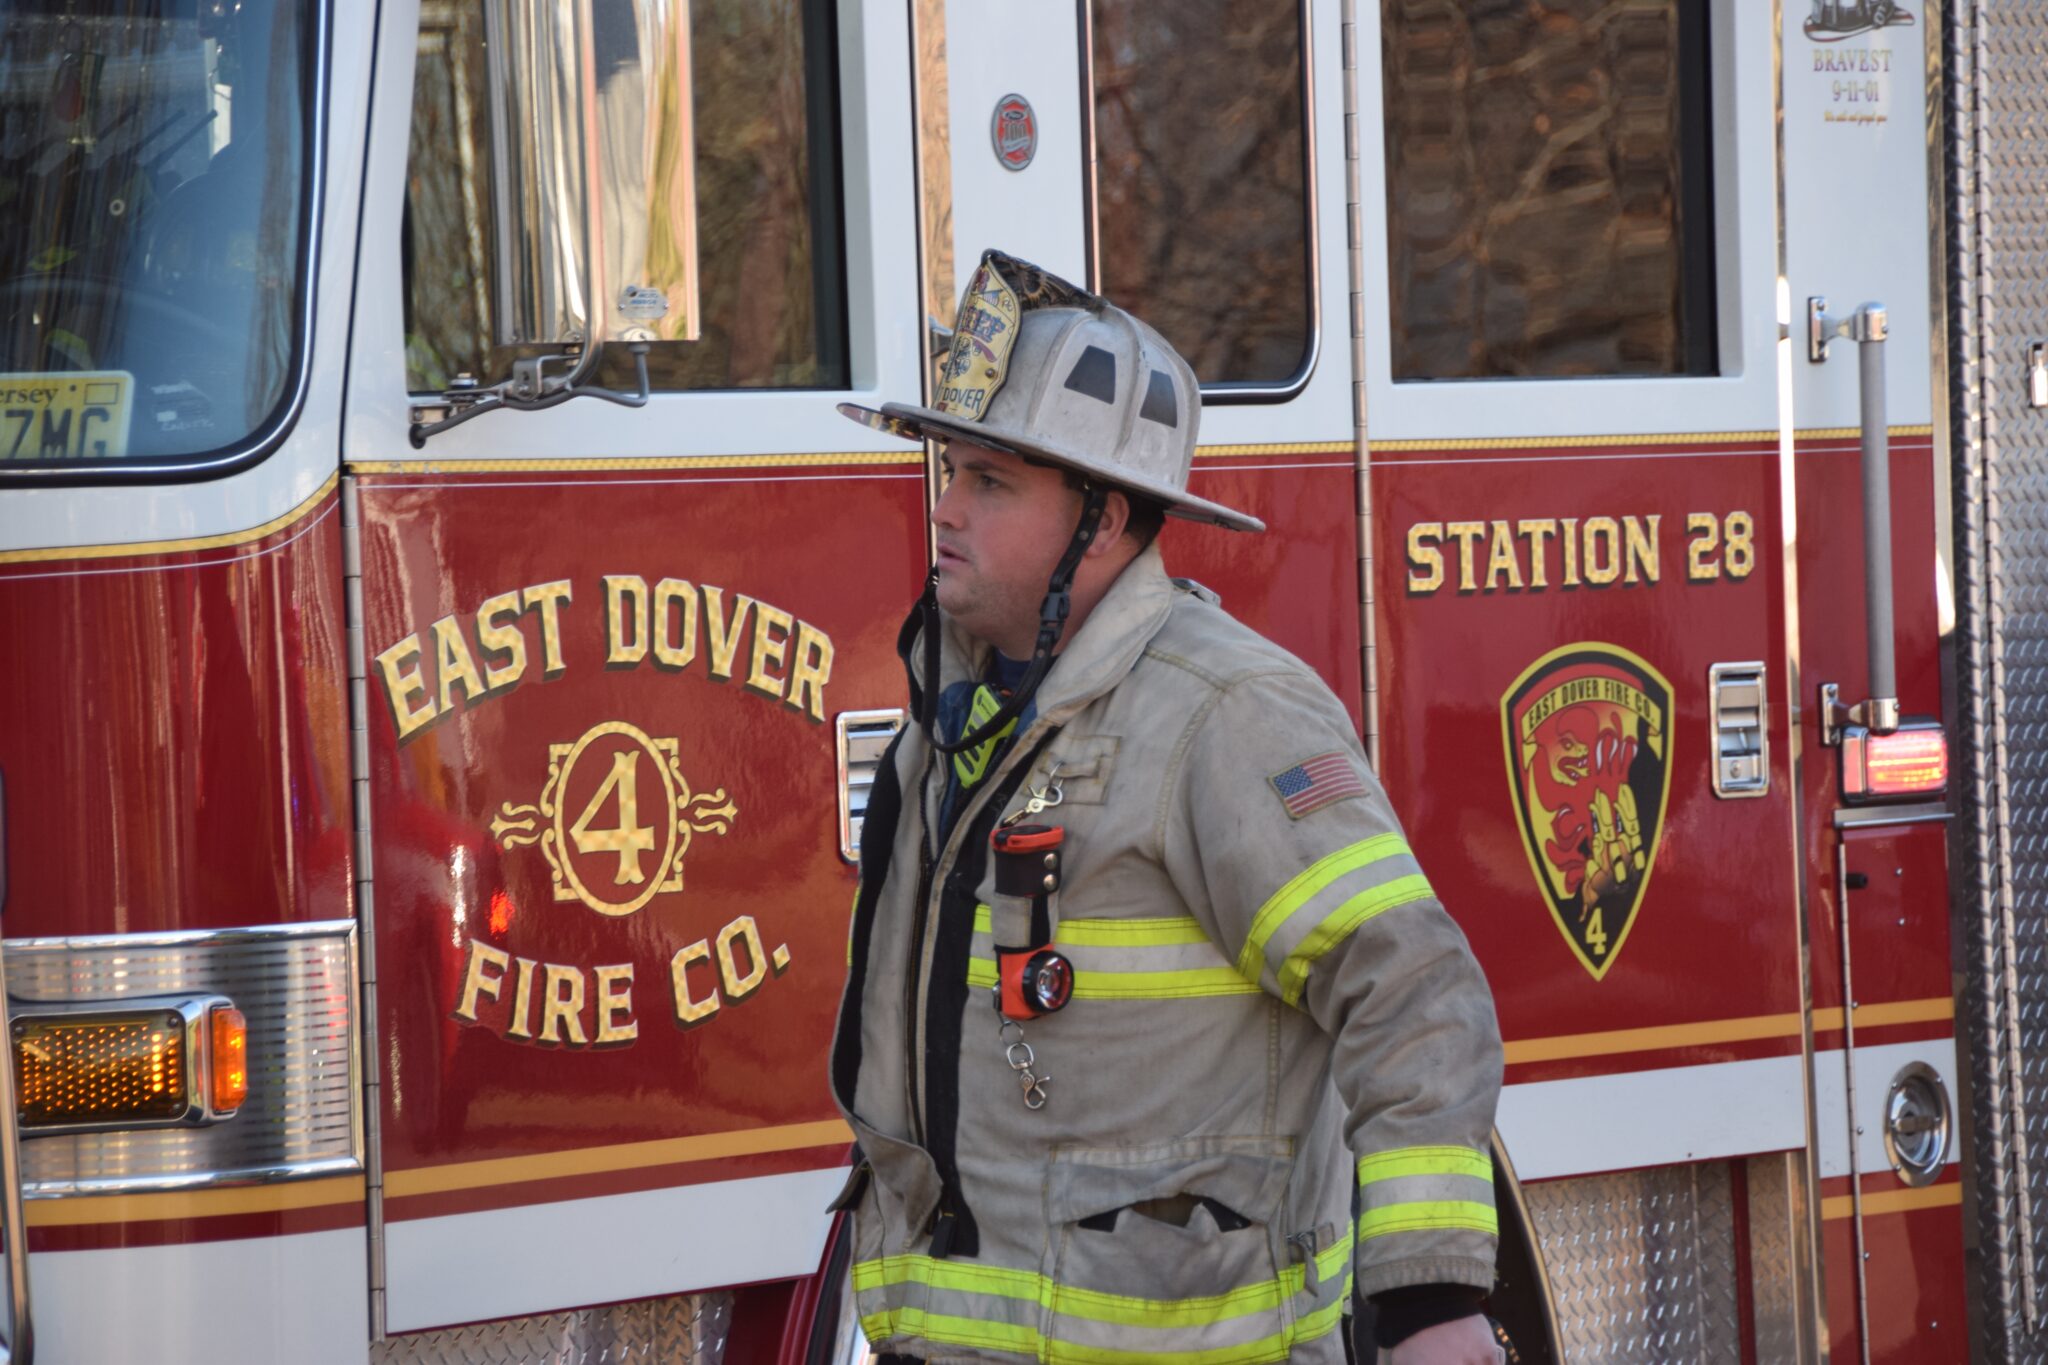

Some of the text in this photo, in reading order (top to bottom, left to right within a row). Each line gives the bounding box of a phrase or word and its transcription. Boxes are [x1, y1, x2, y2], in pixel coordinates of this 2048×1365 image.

[1812, 48, 1892, 72] BRAVEST
[1832, 80, 1879, 102] 9-11-01
[943, 387, 985, 416] DOVER
[1406, 510, 1755, 593] STATION 28
[374, 574, 835, 742] EAST DOVER
[1528, 691, 1557, 731] EAST
[1562, 679, 1600, 705] DOVER
[1604, 680, 1630, 706] FIRE
[569, 750, 655, 885] 4
[1585, 907, 1607, 955] 4
[453, 915, 792, 1046] FIRE CO.
